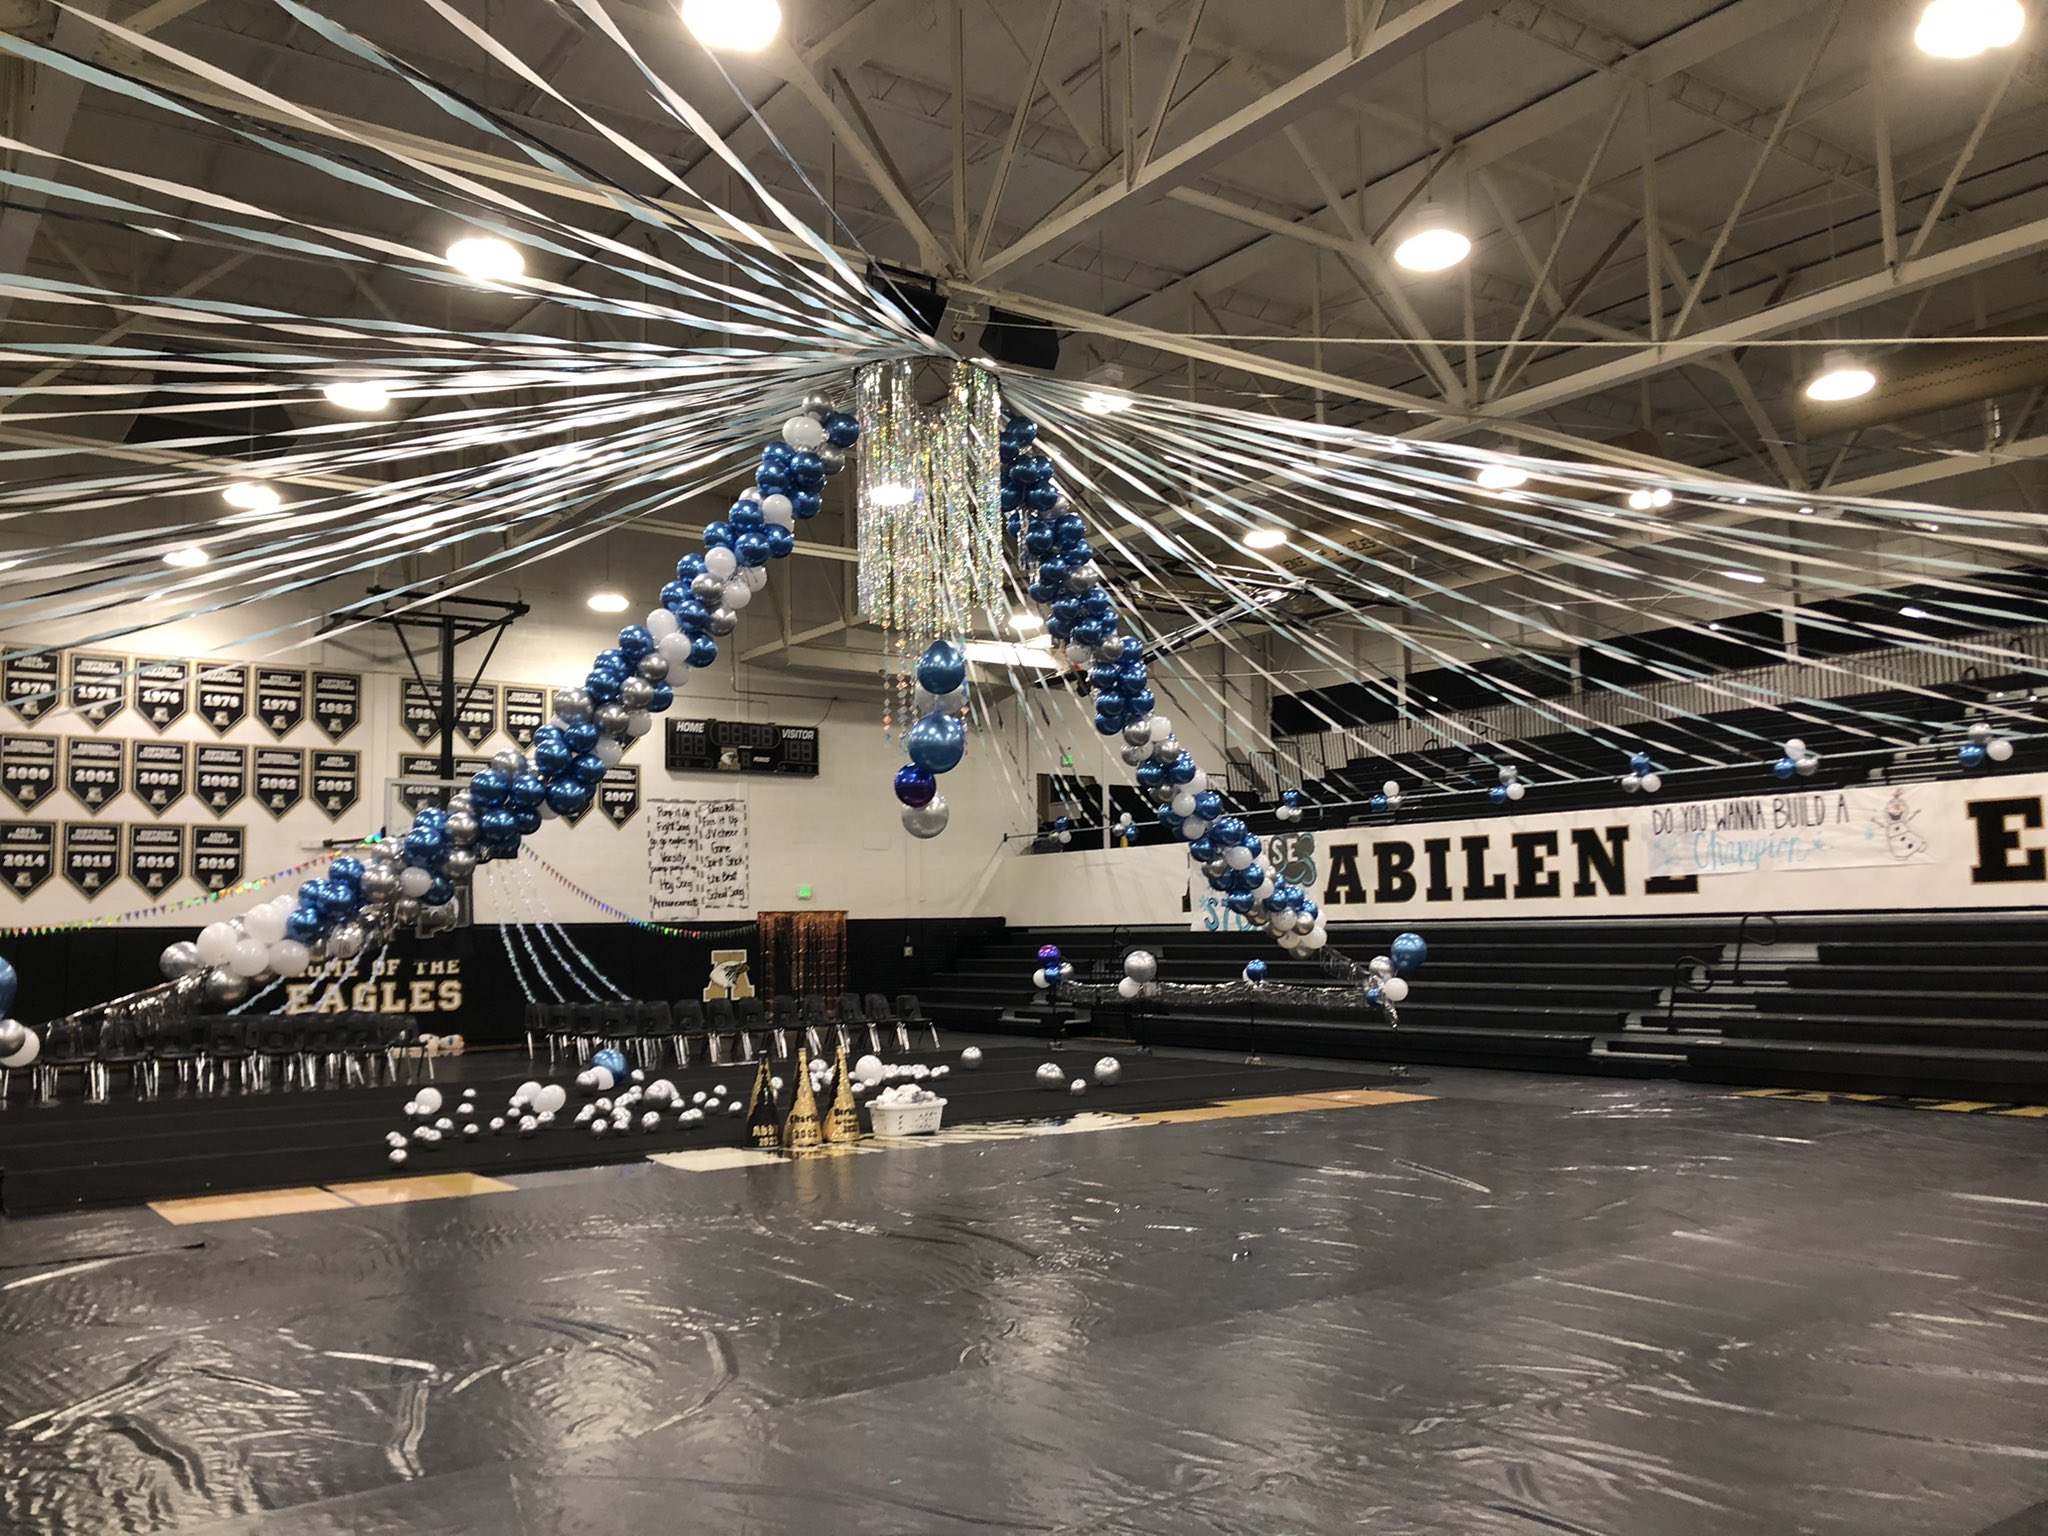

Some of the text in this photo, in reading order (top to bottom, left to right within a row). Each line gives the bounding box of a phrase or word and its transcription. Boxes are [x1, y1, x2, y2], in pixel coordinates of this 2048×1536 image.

[10, 681, 50, 695] 1970
[78, 686, 116, 699] 1975
[142, 690, 180, 704] 1976
[203, 694, 240, 708] 1978
[262, 698, 297, 712] 1978
[318, 702, 353, 715] 1982
[509, 714, 540, 726] 1989
[676, 721, 815, 740] HOME VISITOR
[6, 766, 50, 781] 2000
[75, 769, 116, 783] 2001
[139, 772, 179, 785] 2002
[201, 774, 239, 788] 2002
[260, 777, 297, 790] 2002
[604, 791, 634, 803] 2007
[1652, 794, 1850, 836] DO YOU WANNA BUILD A
[1693, 831, 1809, 870] Champion
[3, 854, 46, 868] 2014
[71, 855, 112, 868] 2015
[136, 855, 175, 869] 2016
[199, 857, 236, 870] 2016
[299, 958, 461, 977] OME OF THE
[285, 979, 463, 1016] EAGLES
